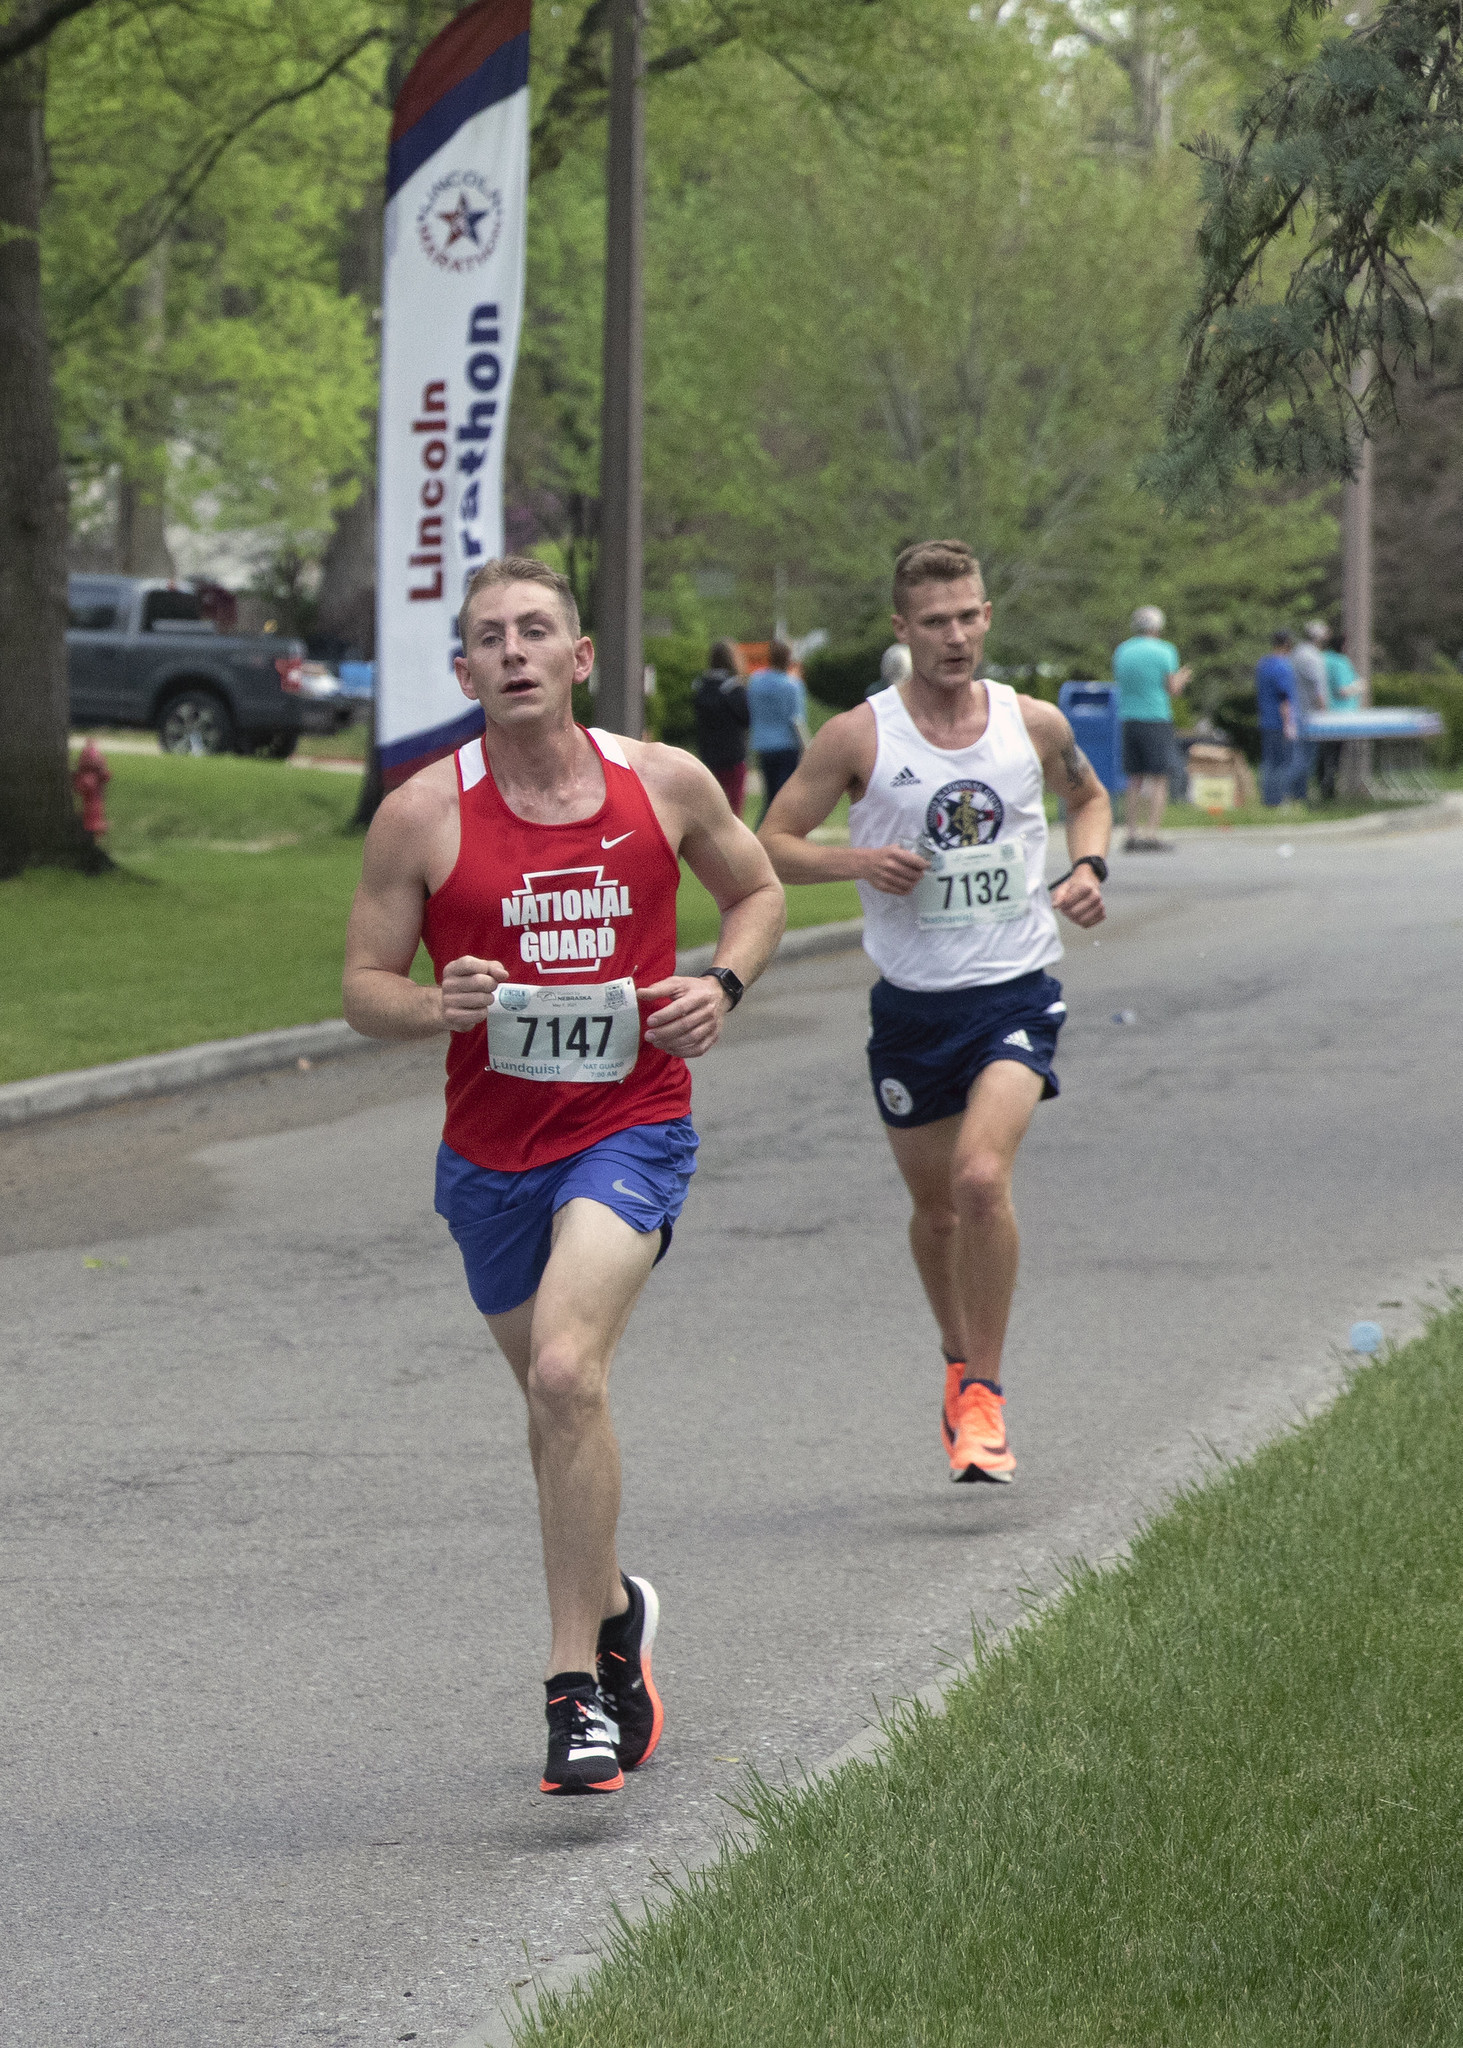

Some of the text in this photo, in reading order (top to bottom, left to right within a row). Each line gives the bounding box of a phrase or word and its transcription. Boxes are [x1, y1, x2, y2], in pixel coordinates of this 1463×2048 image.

[409, 379, 448, 602] Lincoln
[449, 302, 502, 673] rathon
[501, 886, 633, 927] NATIONAL
[938, 869, 1010, 910] 7132
[520, 927, 616, 963] GUARD
[517, 1016, 613, 1057] 7147
[493, 1058, 561, 1076] Lundquist
[599, 1061, 624, 1070] GUARD
